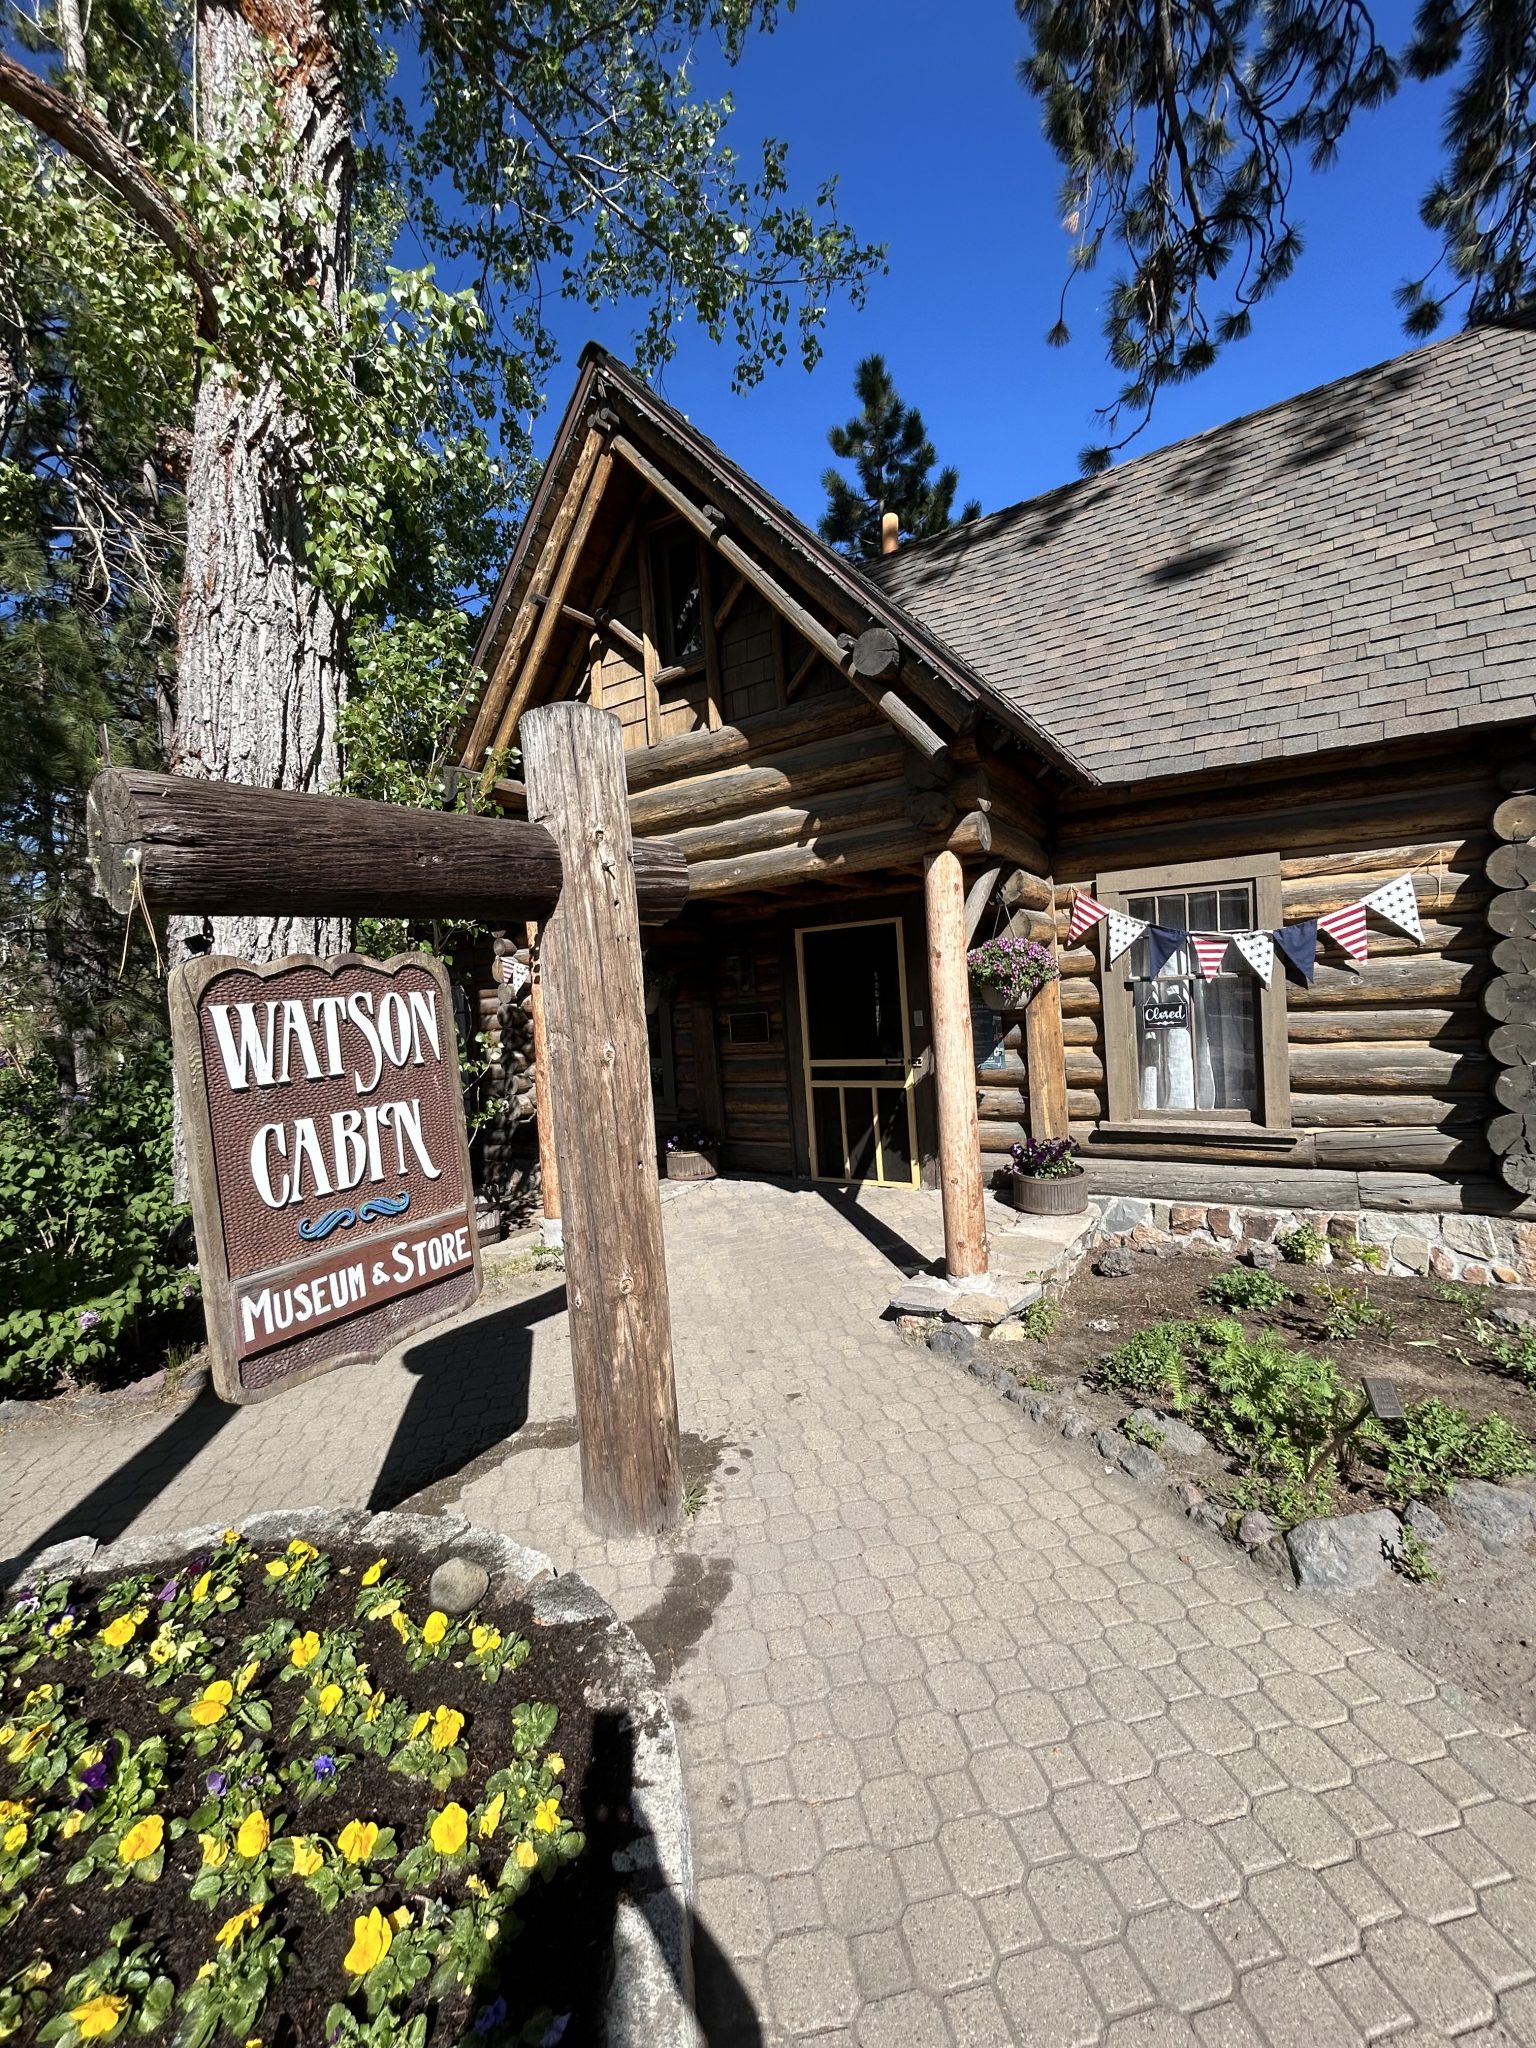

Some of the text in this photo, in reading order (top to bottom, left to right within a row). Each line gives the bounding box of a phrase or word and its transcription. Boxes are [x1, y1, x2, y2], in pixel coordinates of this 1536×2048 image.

[207, 990, 442, 1094] WATSON
[1145, 1005, 1186, 1021] Closed
[250, 1099, 442, 1209] CABIN
[242, 1225, 472, 1343] MUSEUM & STORE
